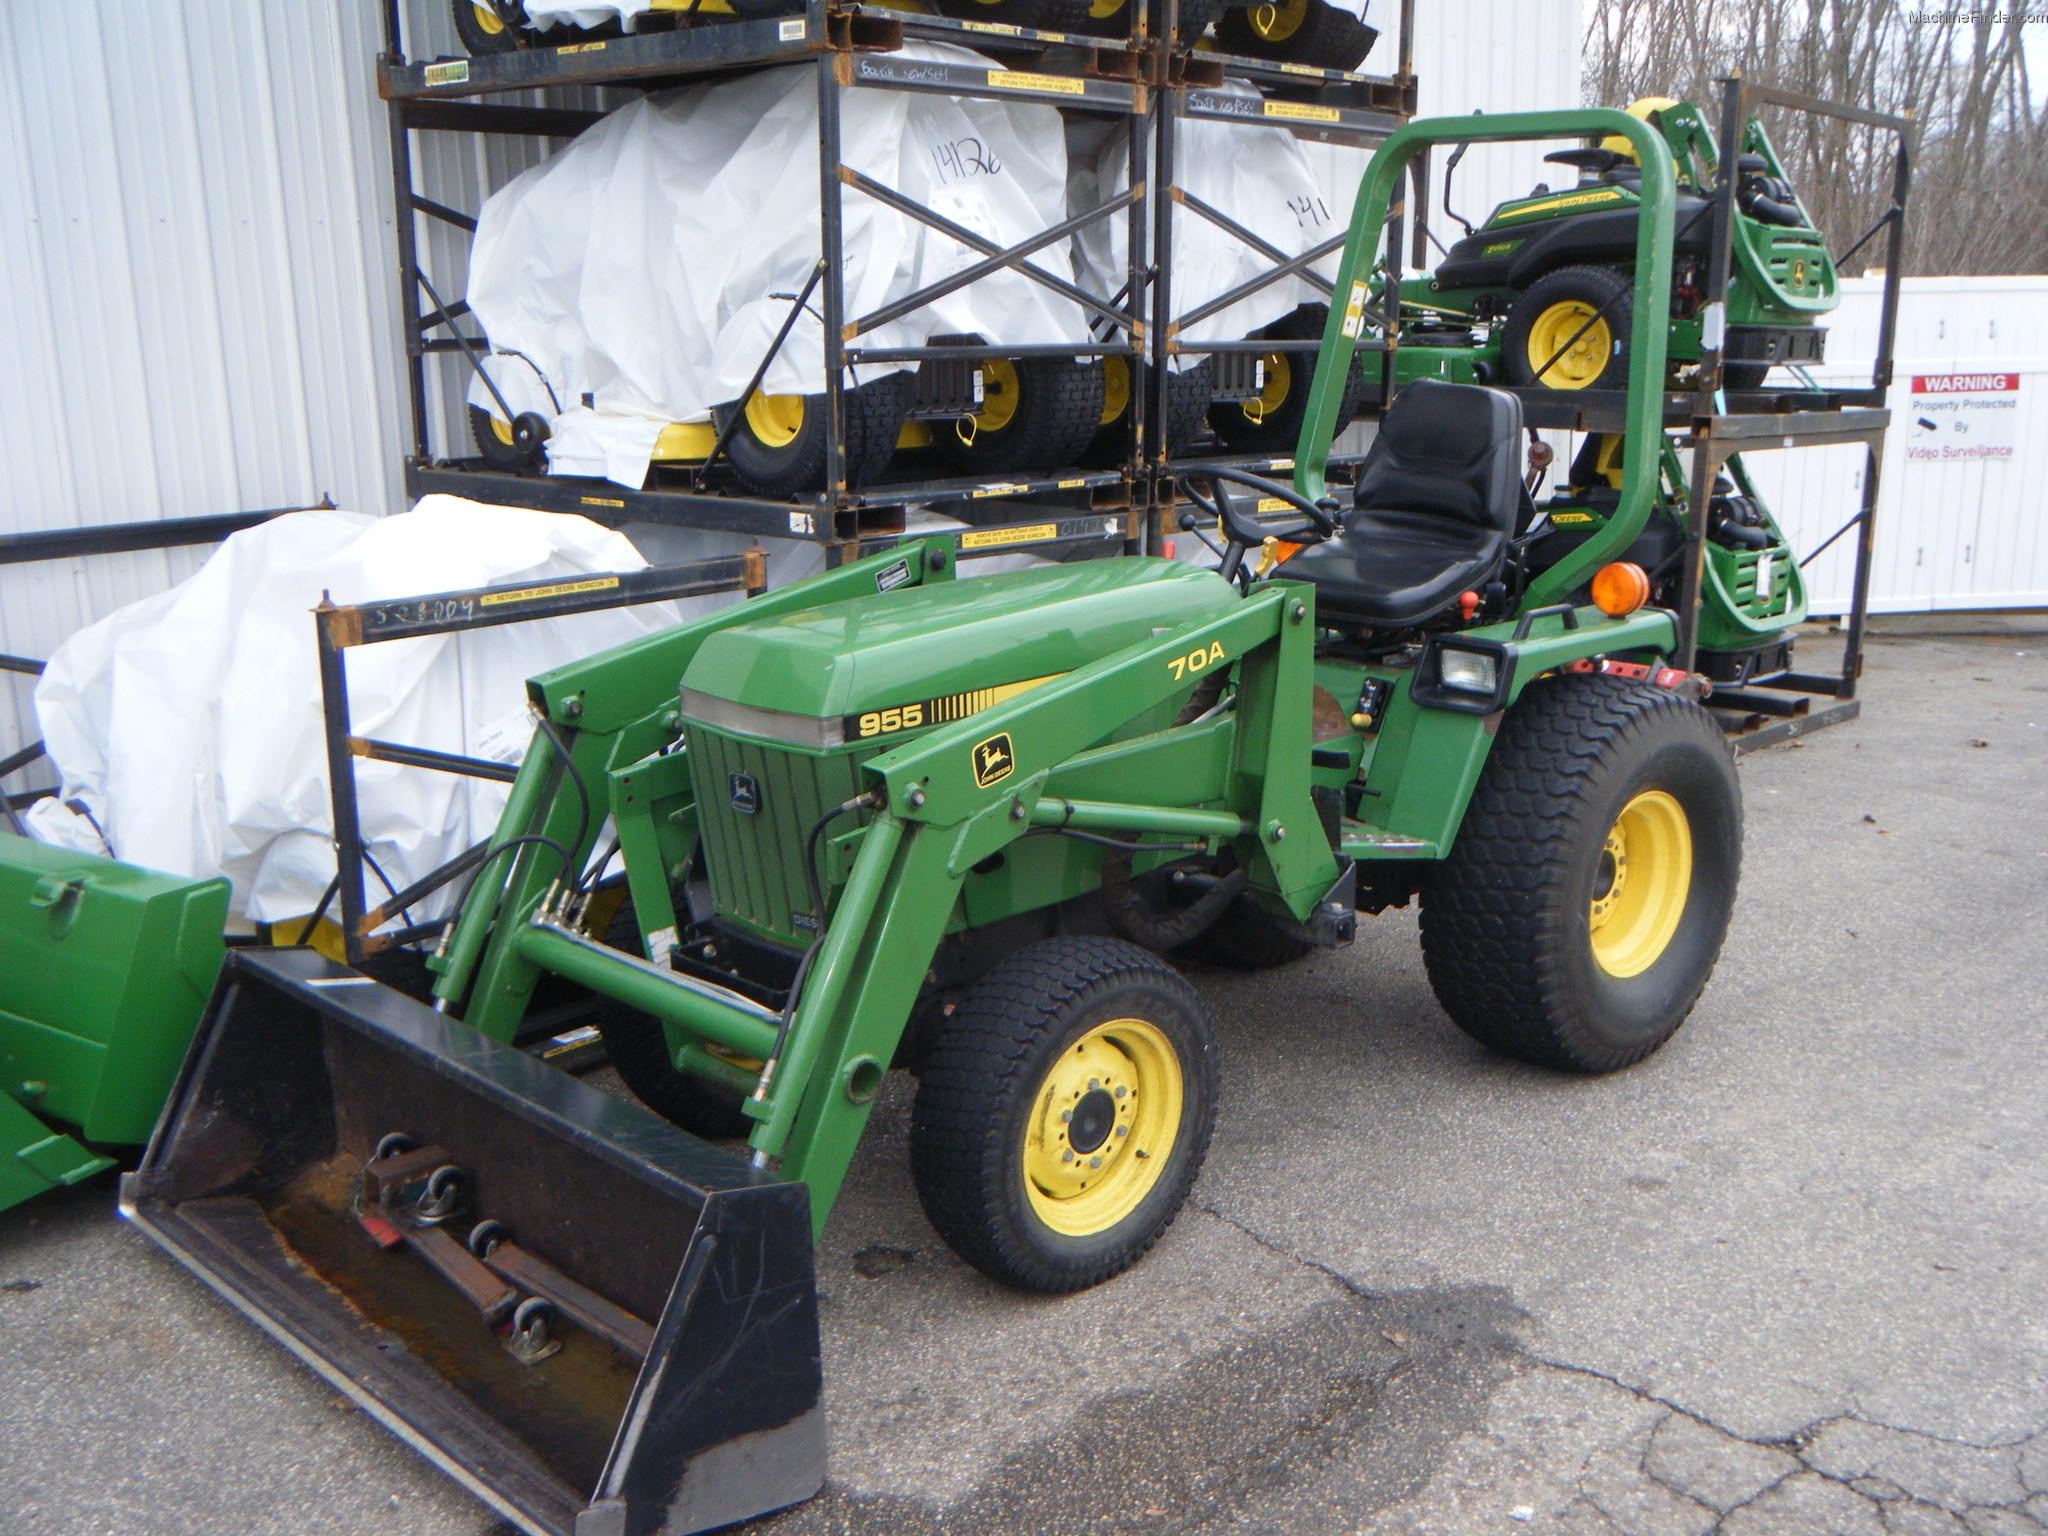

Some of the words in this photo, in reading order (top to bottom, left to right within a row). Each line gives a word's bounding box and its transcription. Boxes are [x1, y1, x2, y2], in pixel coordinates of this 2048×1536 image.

[1925, 375, 2007, 392] WARNING
[1913, 400, 1959, 412] Property
[1962, 399, 2016, 410] Protected
[1955, 421, 1969, 433] By
[1907, 447, 1939, 459] Video
[1942, 445, 2013, 458] Surveillance
[497, 591, 522, 600] RETURN
[535, 588, 552, 596] JOHN
[555, 584, 575, 593] DEERE
[577, 581, 604, 590] HORICON
[1167, 641, 1226, 681] 70A
[859, 703, 923, 737] 955
[981, 775, 995, 785] JOHN
[994, 765, 1011, 779] DEERE
[793, 914, 818, 928] DIES
